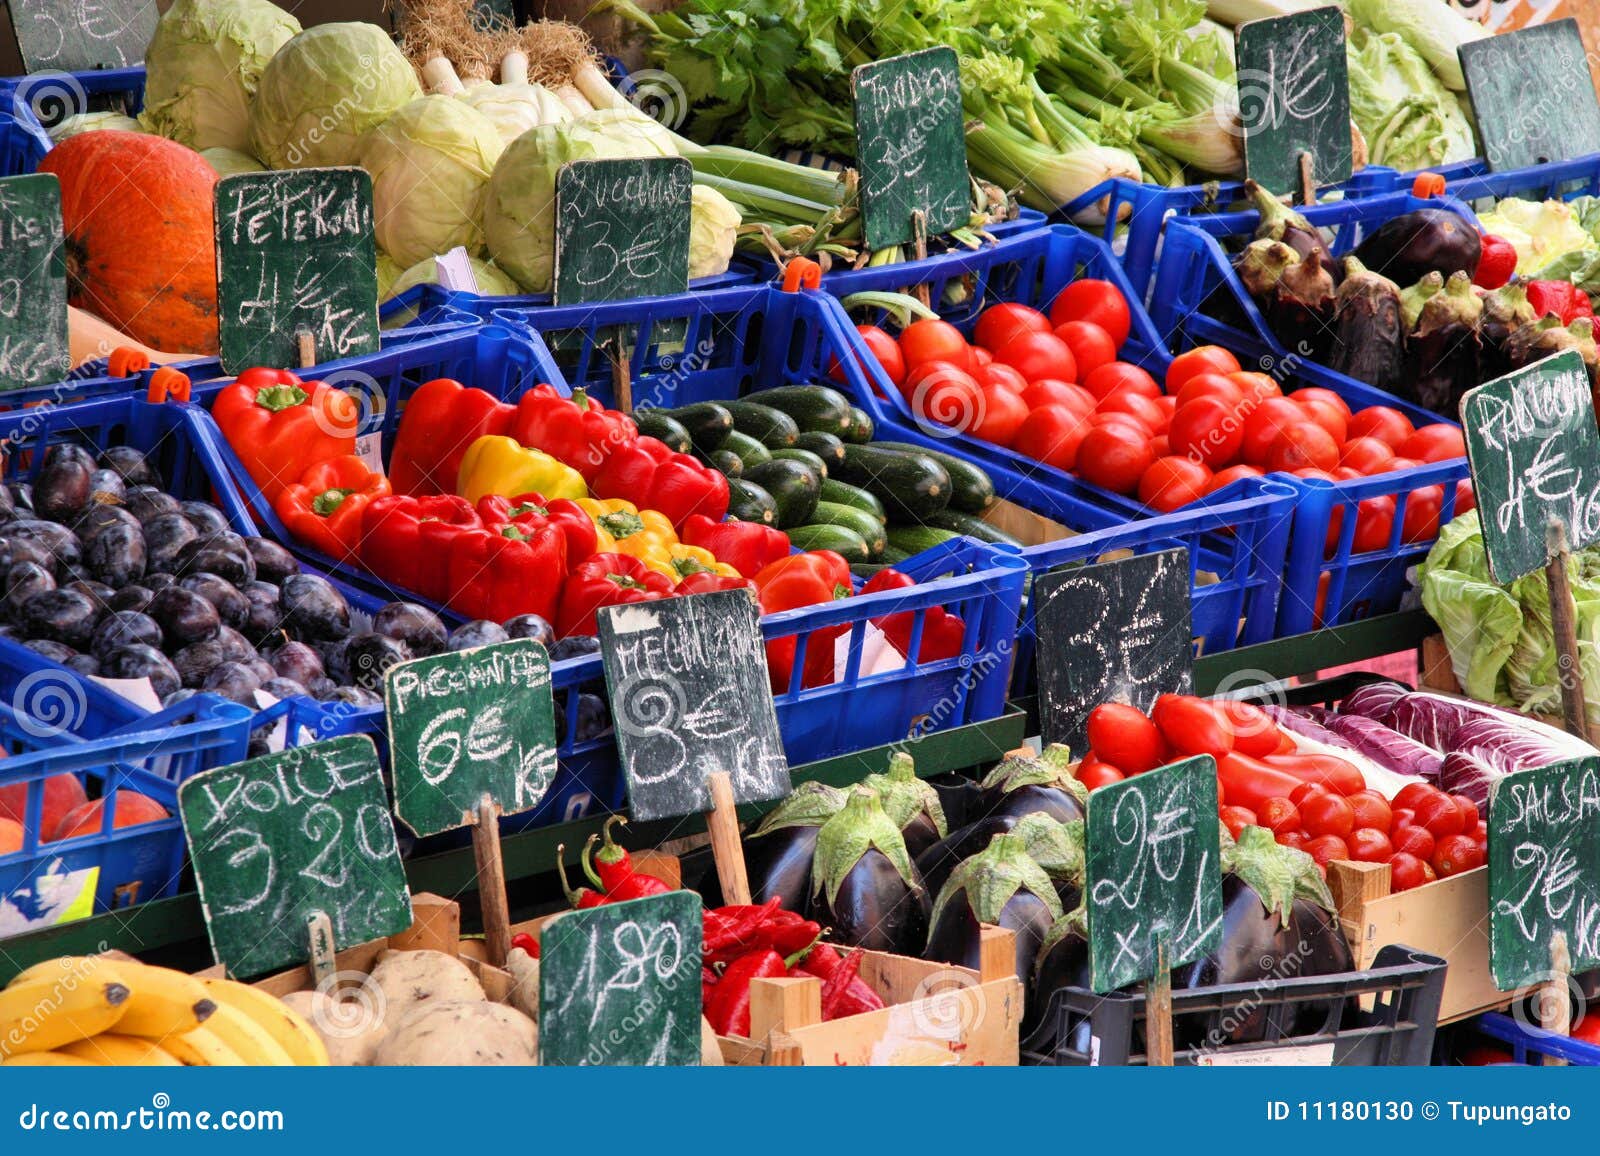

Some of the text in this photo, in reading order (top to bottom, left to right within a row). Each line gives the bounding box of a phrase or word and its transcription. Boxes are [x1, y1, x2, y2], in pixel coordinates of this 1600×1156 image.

[576, 220, 662, 286] 3€
[1048, 556, 1180, 714] 3€
[416, 698, 514, 786] 6€
[1500, 768, 1600, 835] SALSA
